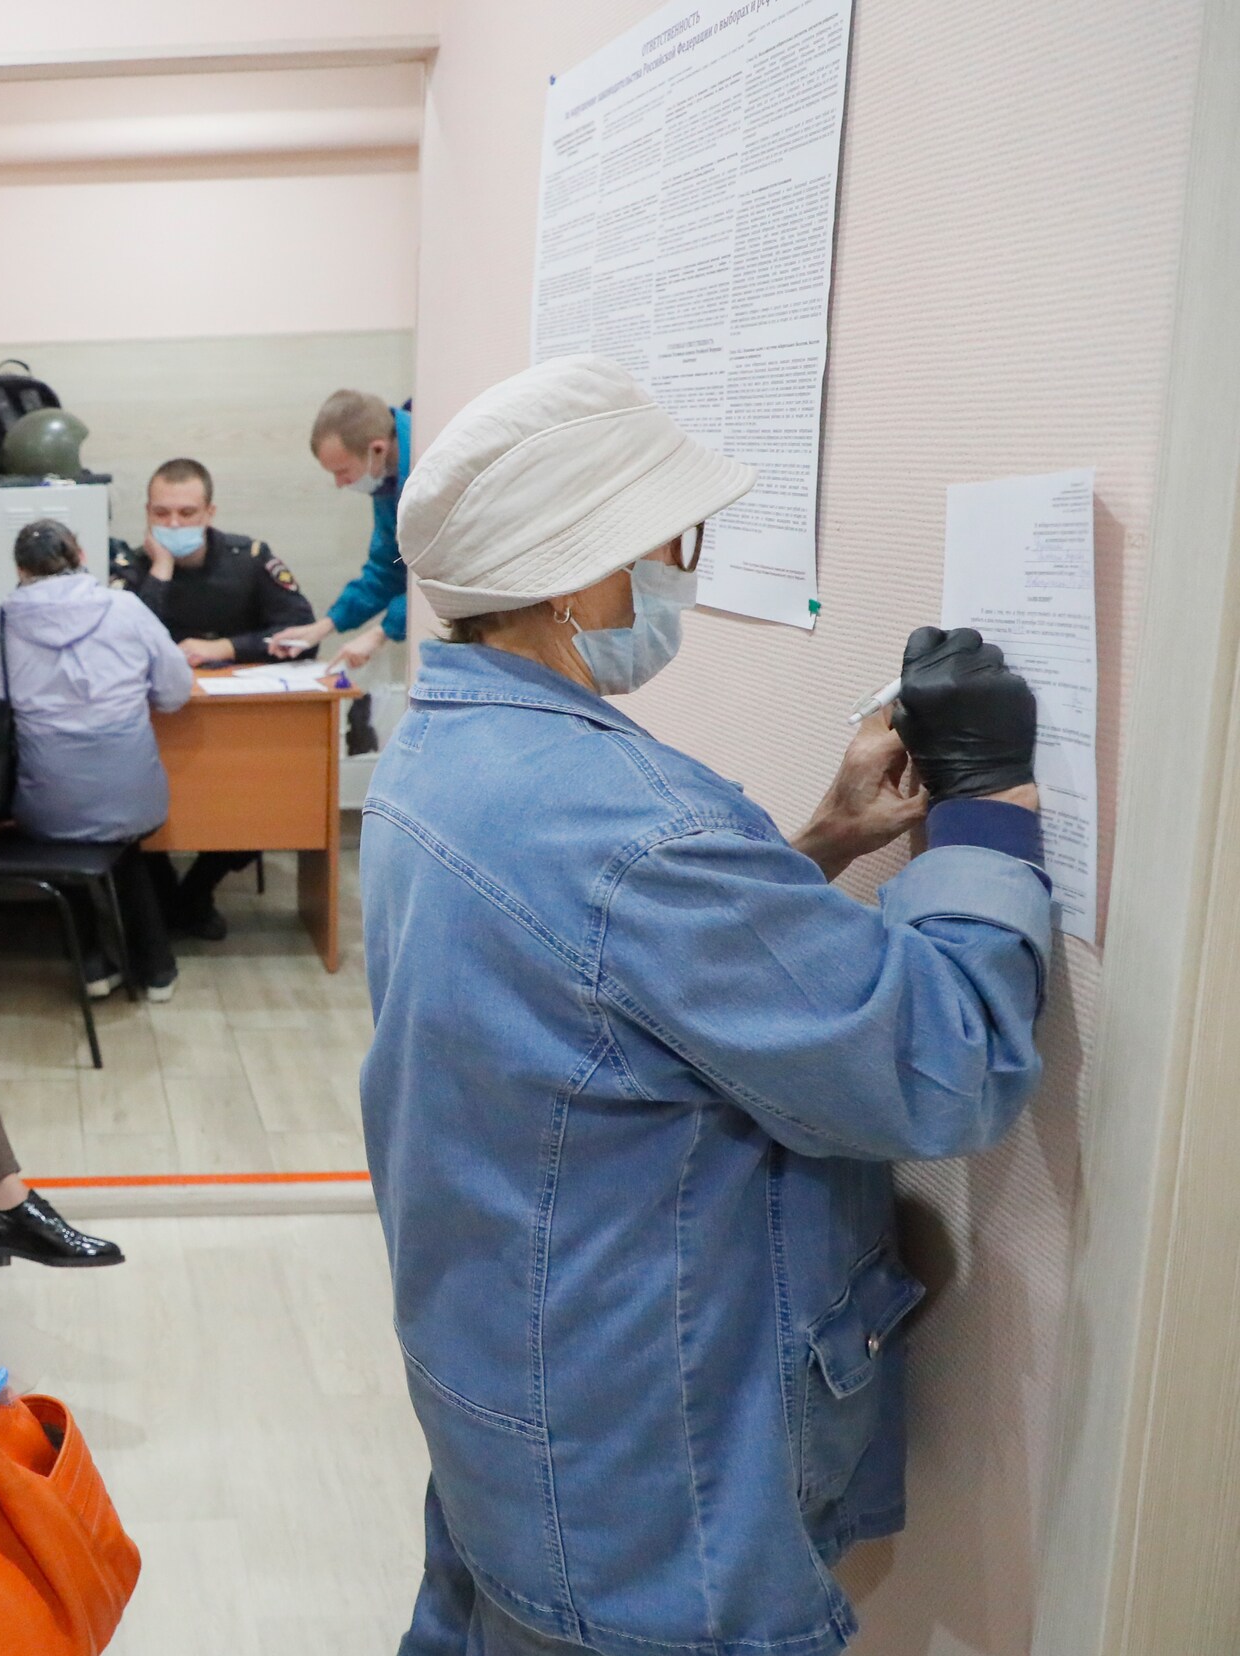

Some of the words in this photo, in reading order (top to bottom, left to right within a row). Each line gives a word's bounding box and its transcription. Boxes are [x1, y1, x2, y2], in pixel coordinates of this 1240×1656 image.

[641, 10, 701, 57] ОТВЕТСТВЕННОСТЬ
[677, 26, 713, 55] Федерации
[719, 4, 750, 31] выборах
